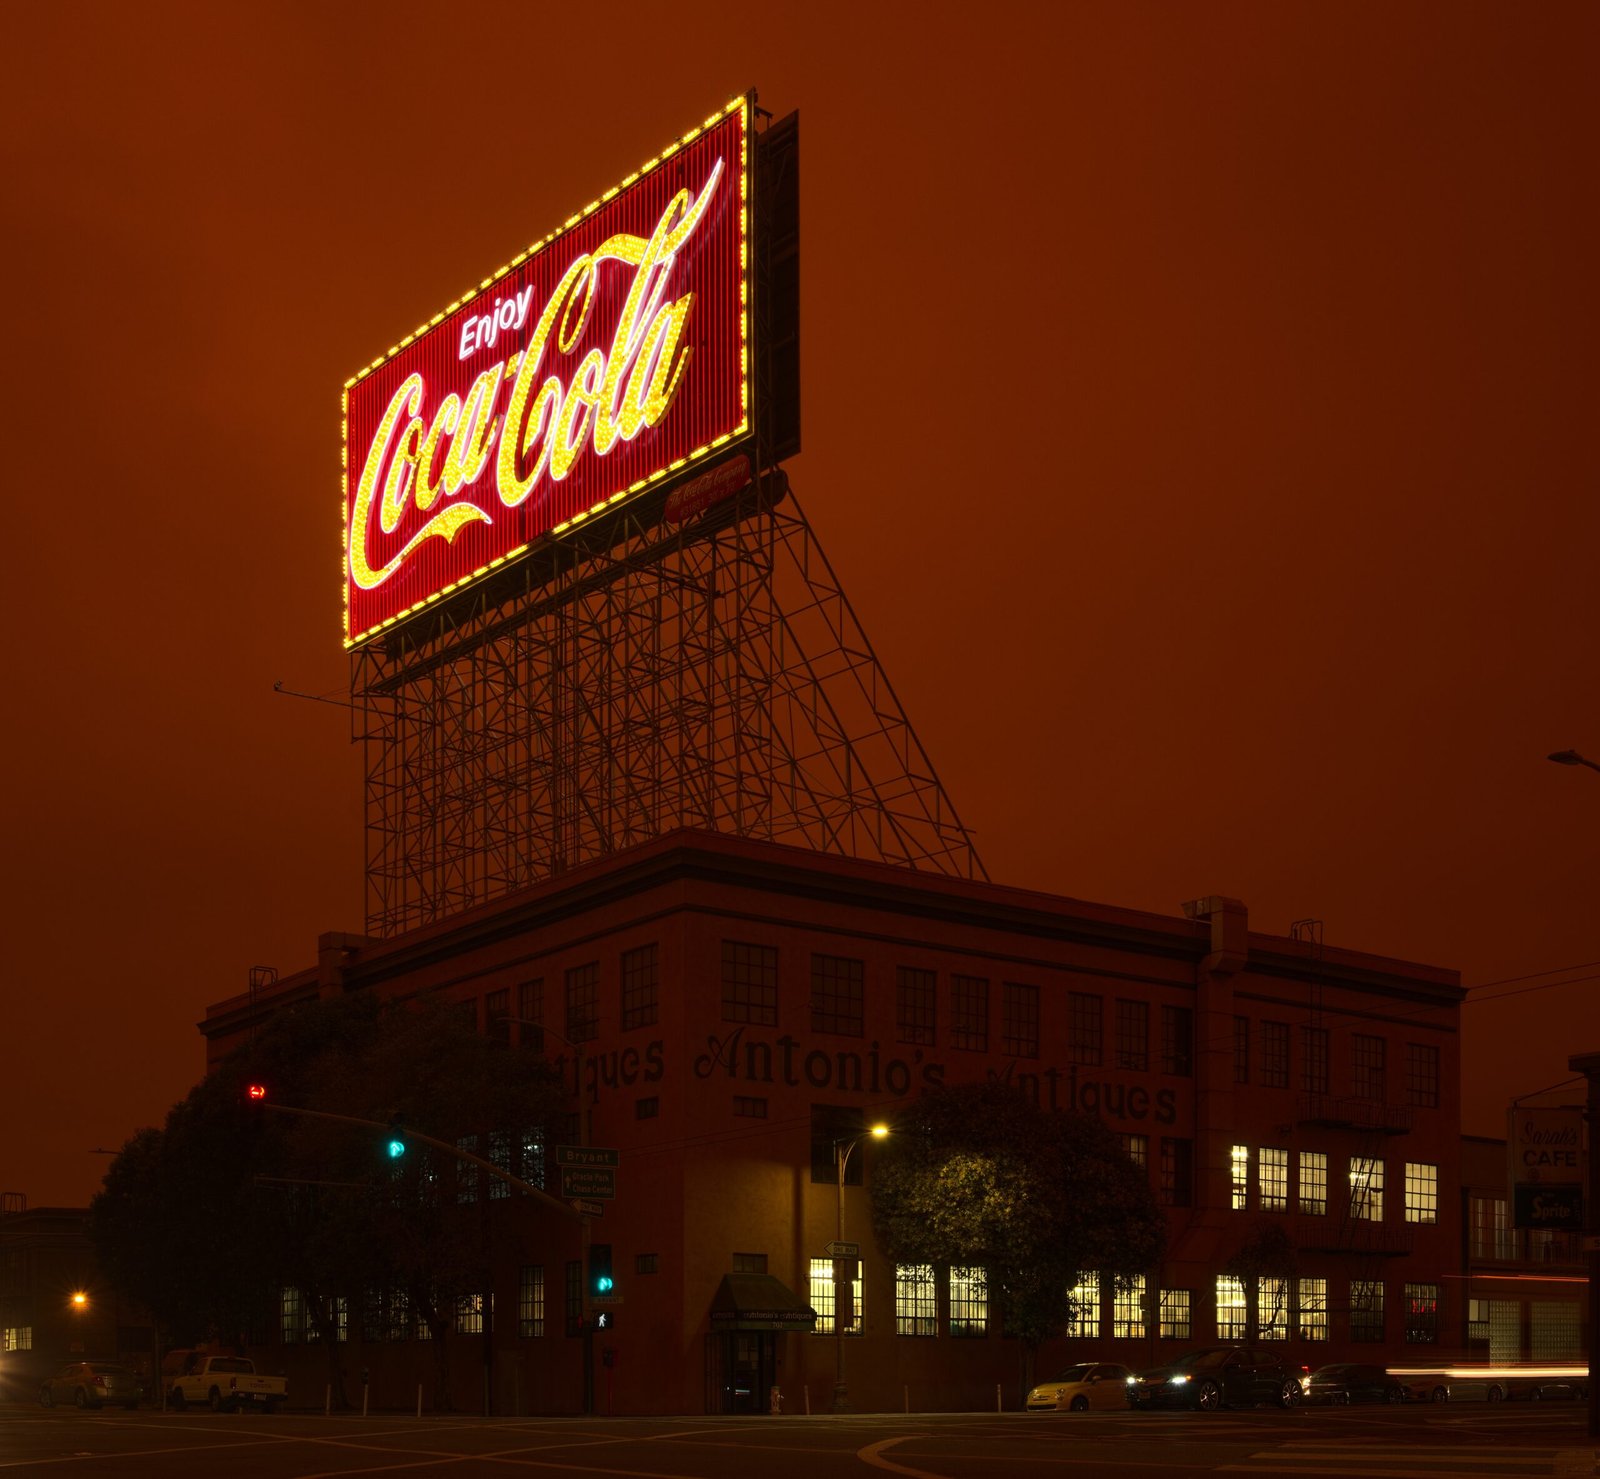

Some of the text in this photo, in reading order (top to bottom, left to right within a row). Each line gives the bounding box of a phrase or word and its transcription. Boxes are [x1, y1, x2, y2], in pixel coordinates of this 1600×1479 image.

[458, 284, 535, 361] Enjoy
[555, 1040, 664, 1105] tiques
[692, 1025, 946, 1098] Antonio's
[1519, 1120, 1577, 1145] Sarah's
[567, 1150, 609, 1164] Bryant
[1522, 1149, 1577, 1167] CAFE
[1531, 1196, 1571, 1221] Sprite
